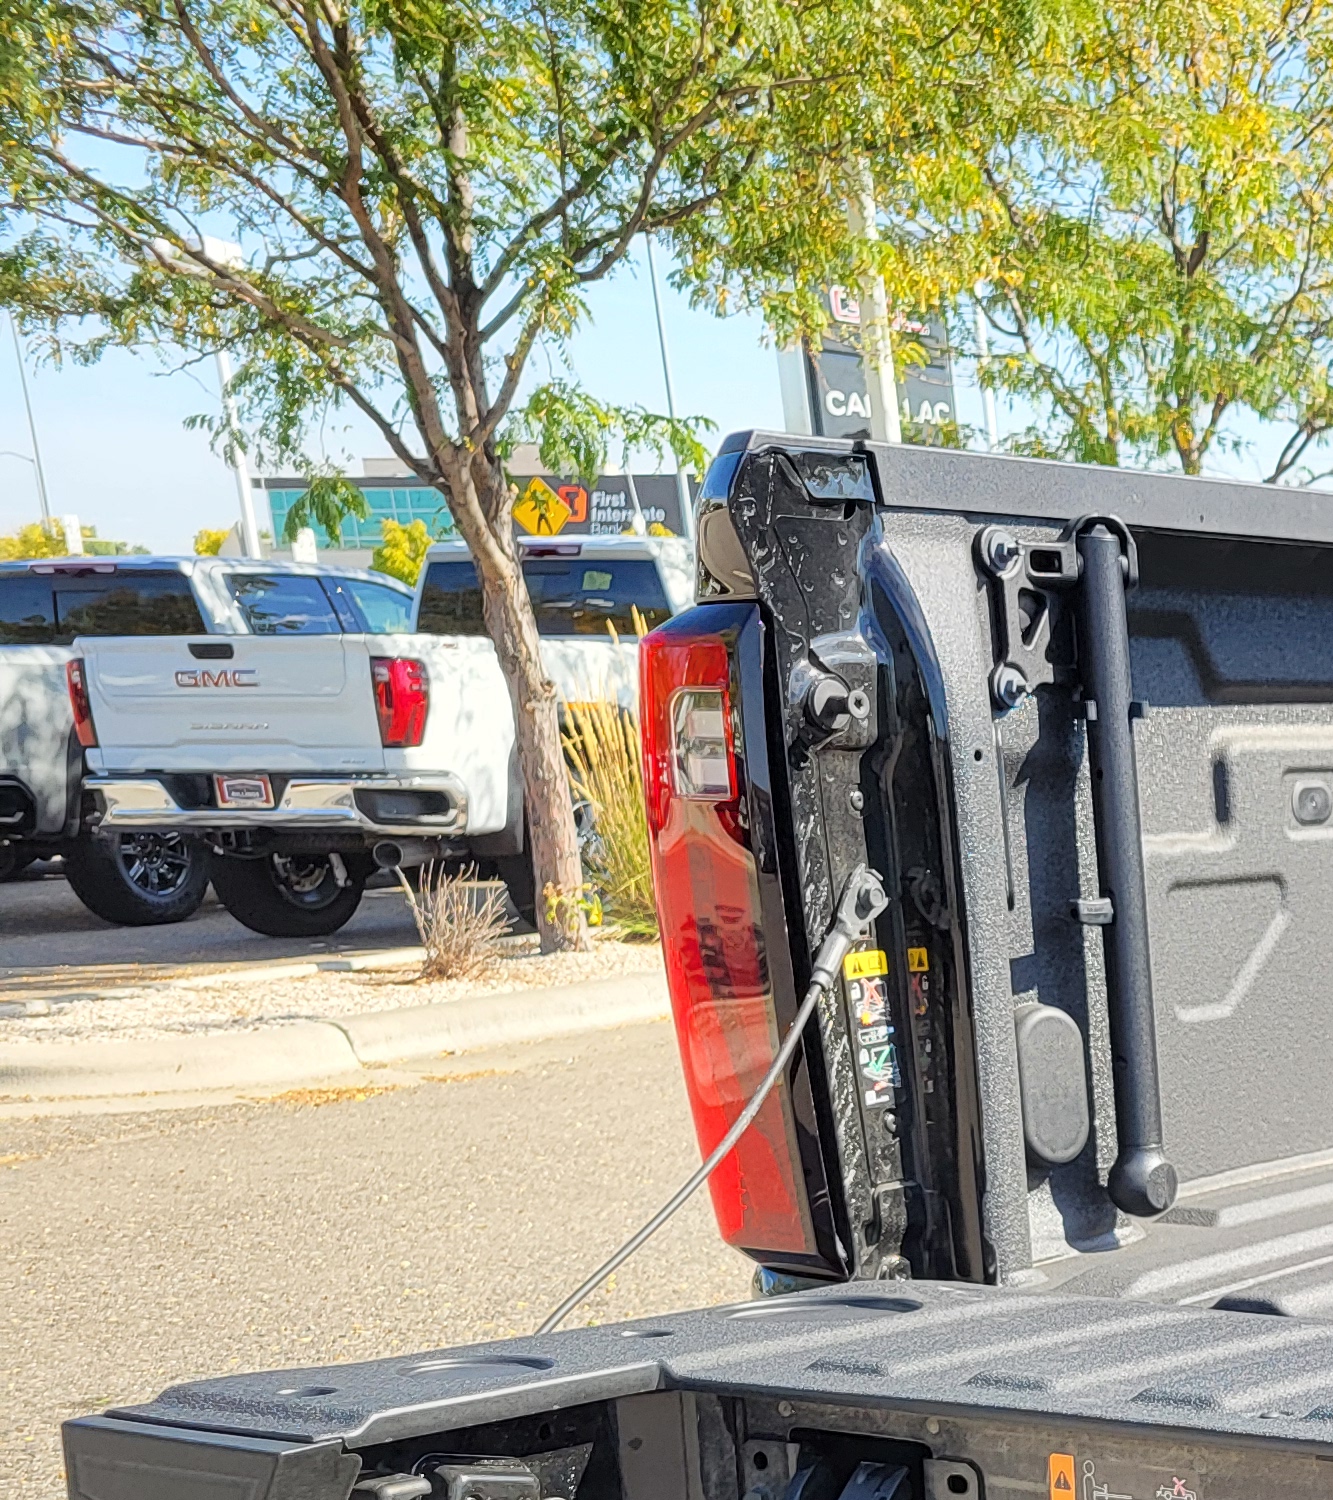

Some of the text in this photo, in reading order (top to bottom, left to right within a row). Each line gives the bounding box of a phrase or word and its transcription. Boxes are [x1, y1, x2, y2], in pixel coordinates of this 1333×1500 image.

[591, 490, 626, 508] First
[590, 522, 623, 535] Bank
[174, 669, 260, 688] GMC
